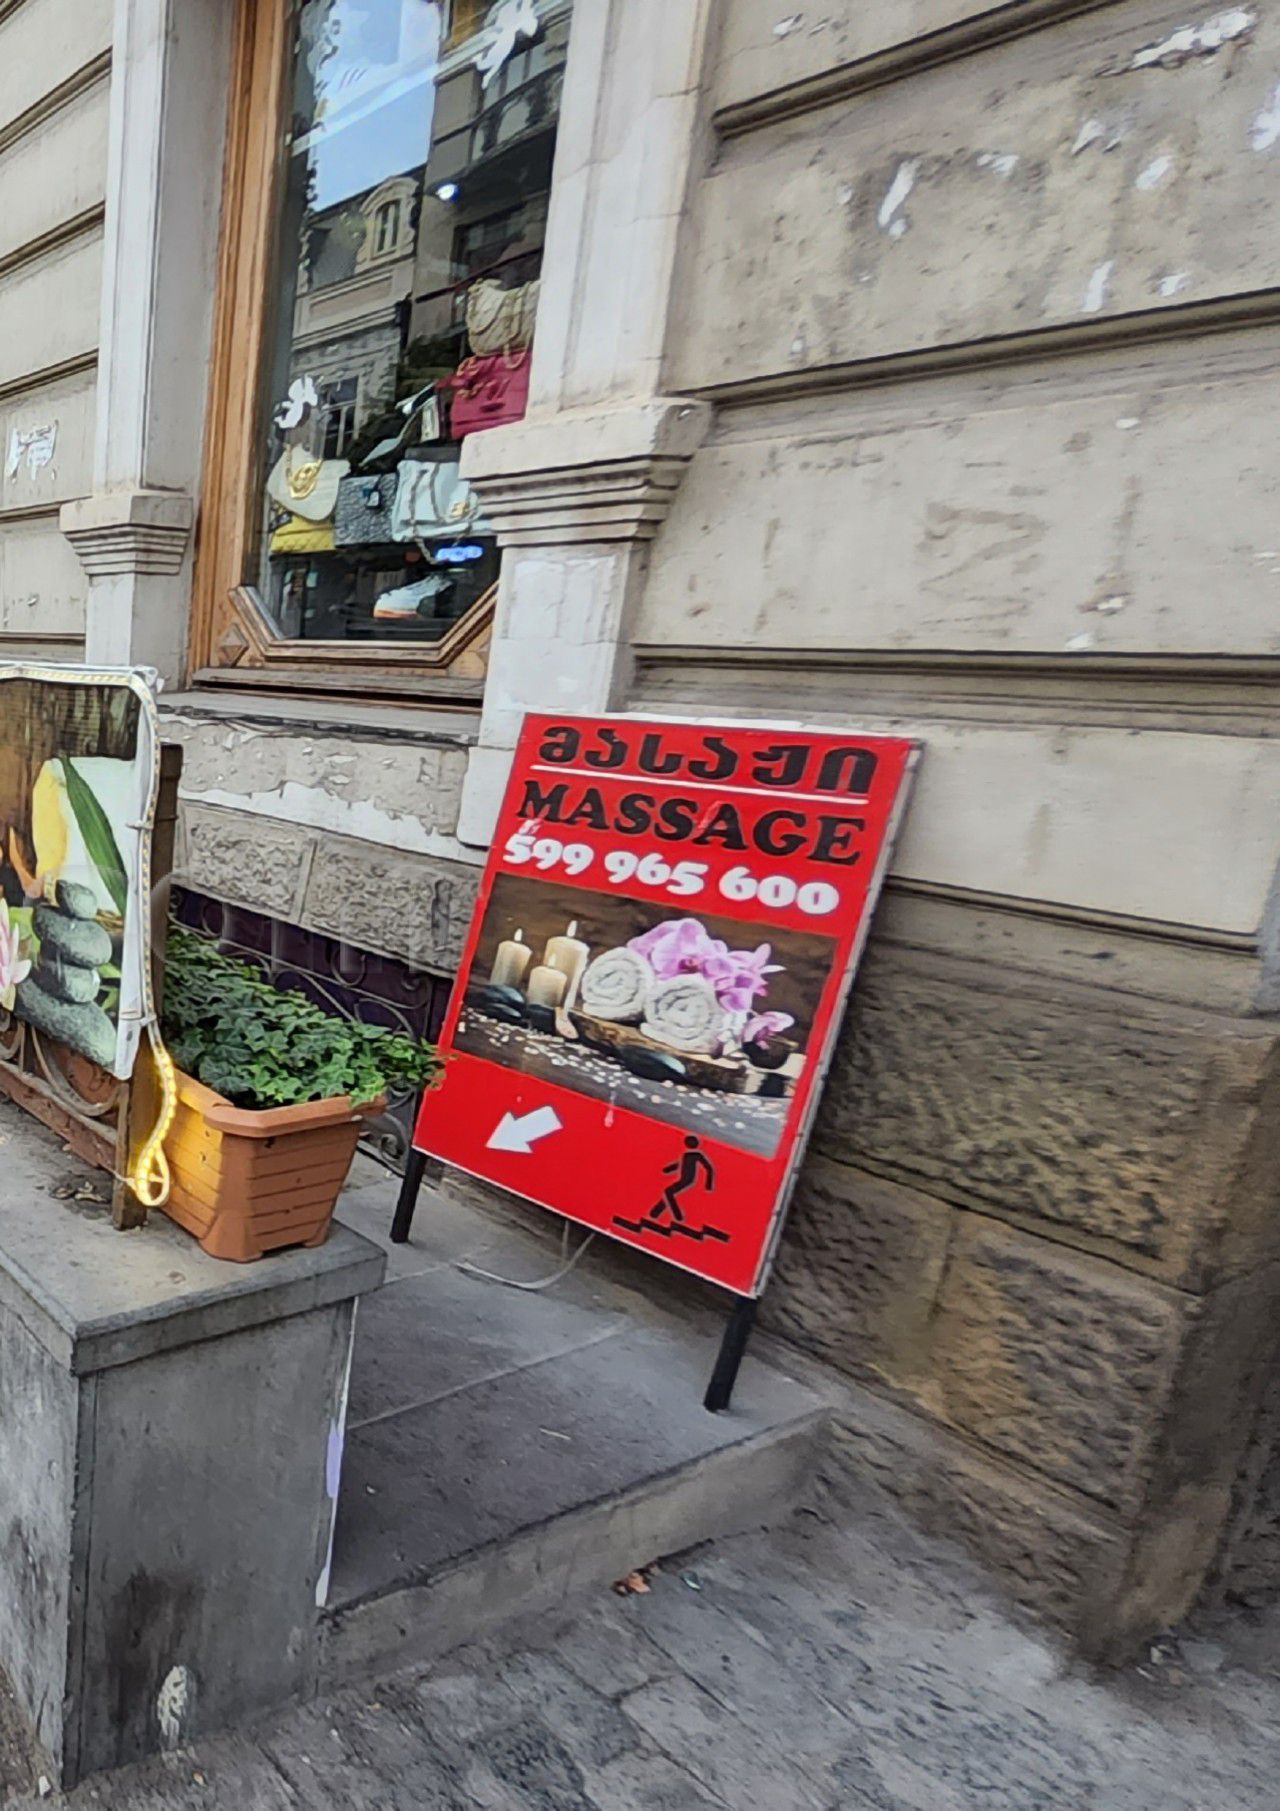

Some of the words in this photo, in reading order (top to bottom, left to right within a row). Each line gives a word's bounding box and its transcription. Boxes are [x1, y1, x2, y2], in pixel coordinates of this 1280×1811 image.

[537, 726, 879, 795] მასაჟი
[516, 781, 867, 865] MASSAGE
[503, 834, 595, 875] 599
[604, 852, 709, 895] 965
[719, 866, 840, 914] 600
